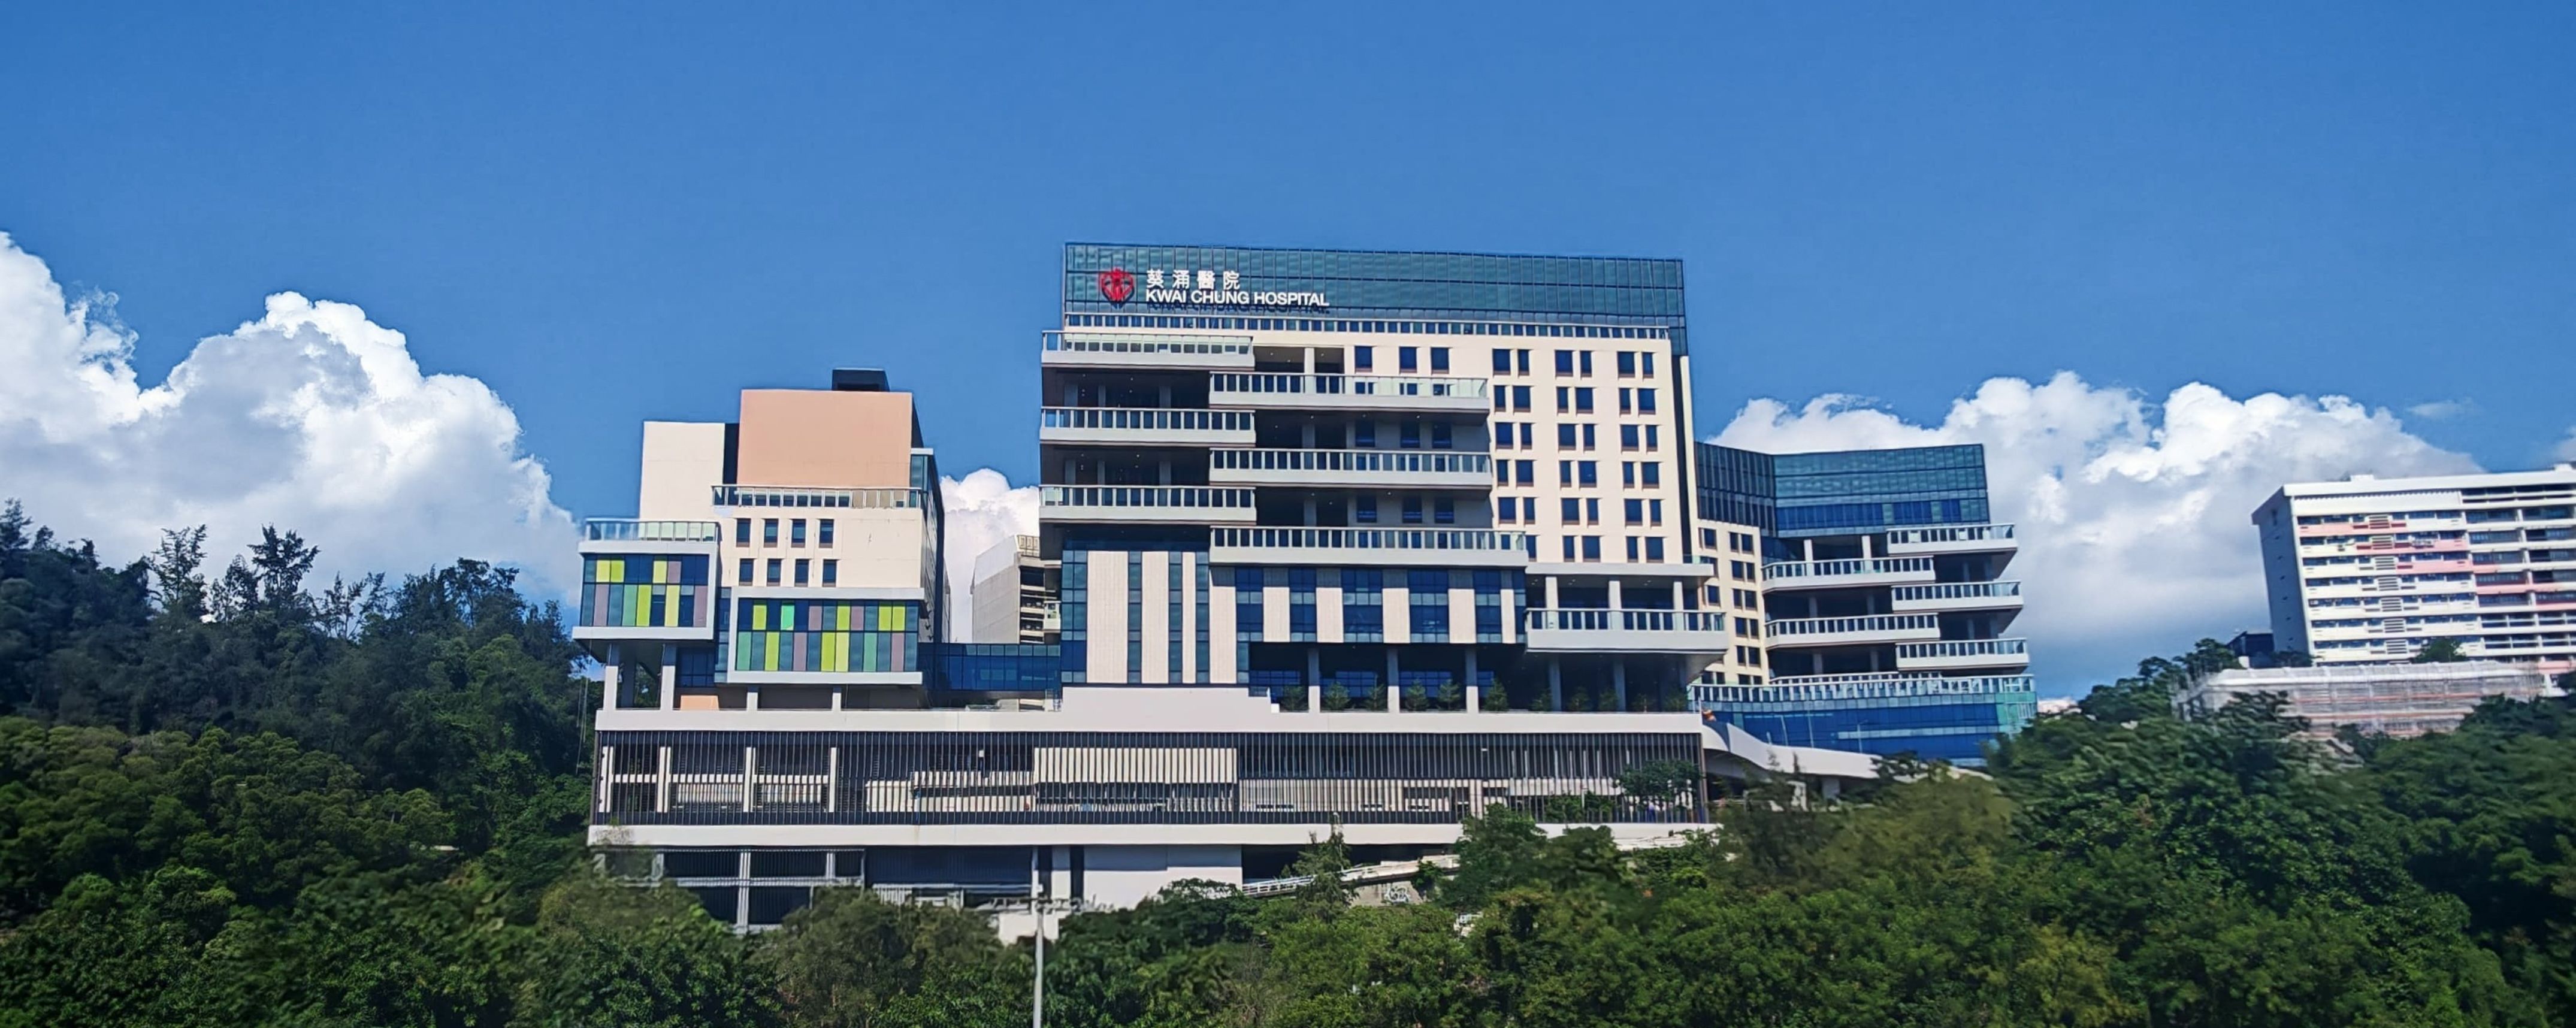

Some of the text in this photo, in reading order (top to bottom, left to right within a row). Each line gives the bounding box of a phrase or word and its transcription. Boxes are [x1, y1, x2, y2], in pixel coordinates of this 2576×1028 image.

[1147, 270, 1240, 290] 葵涌醫院
[1145, 290, 1330, 306] KWAI CHUNG HOSPITAL
